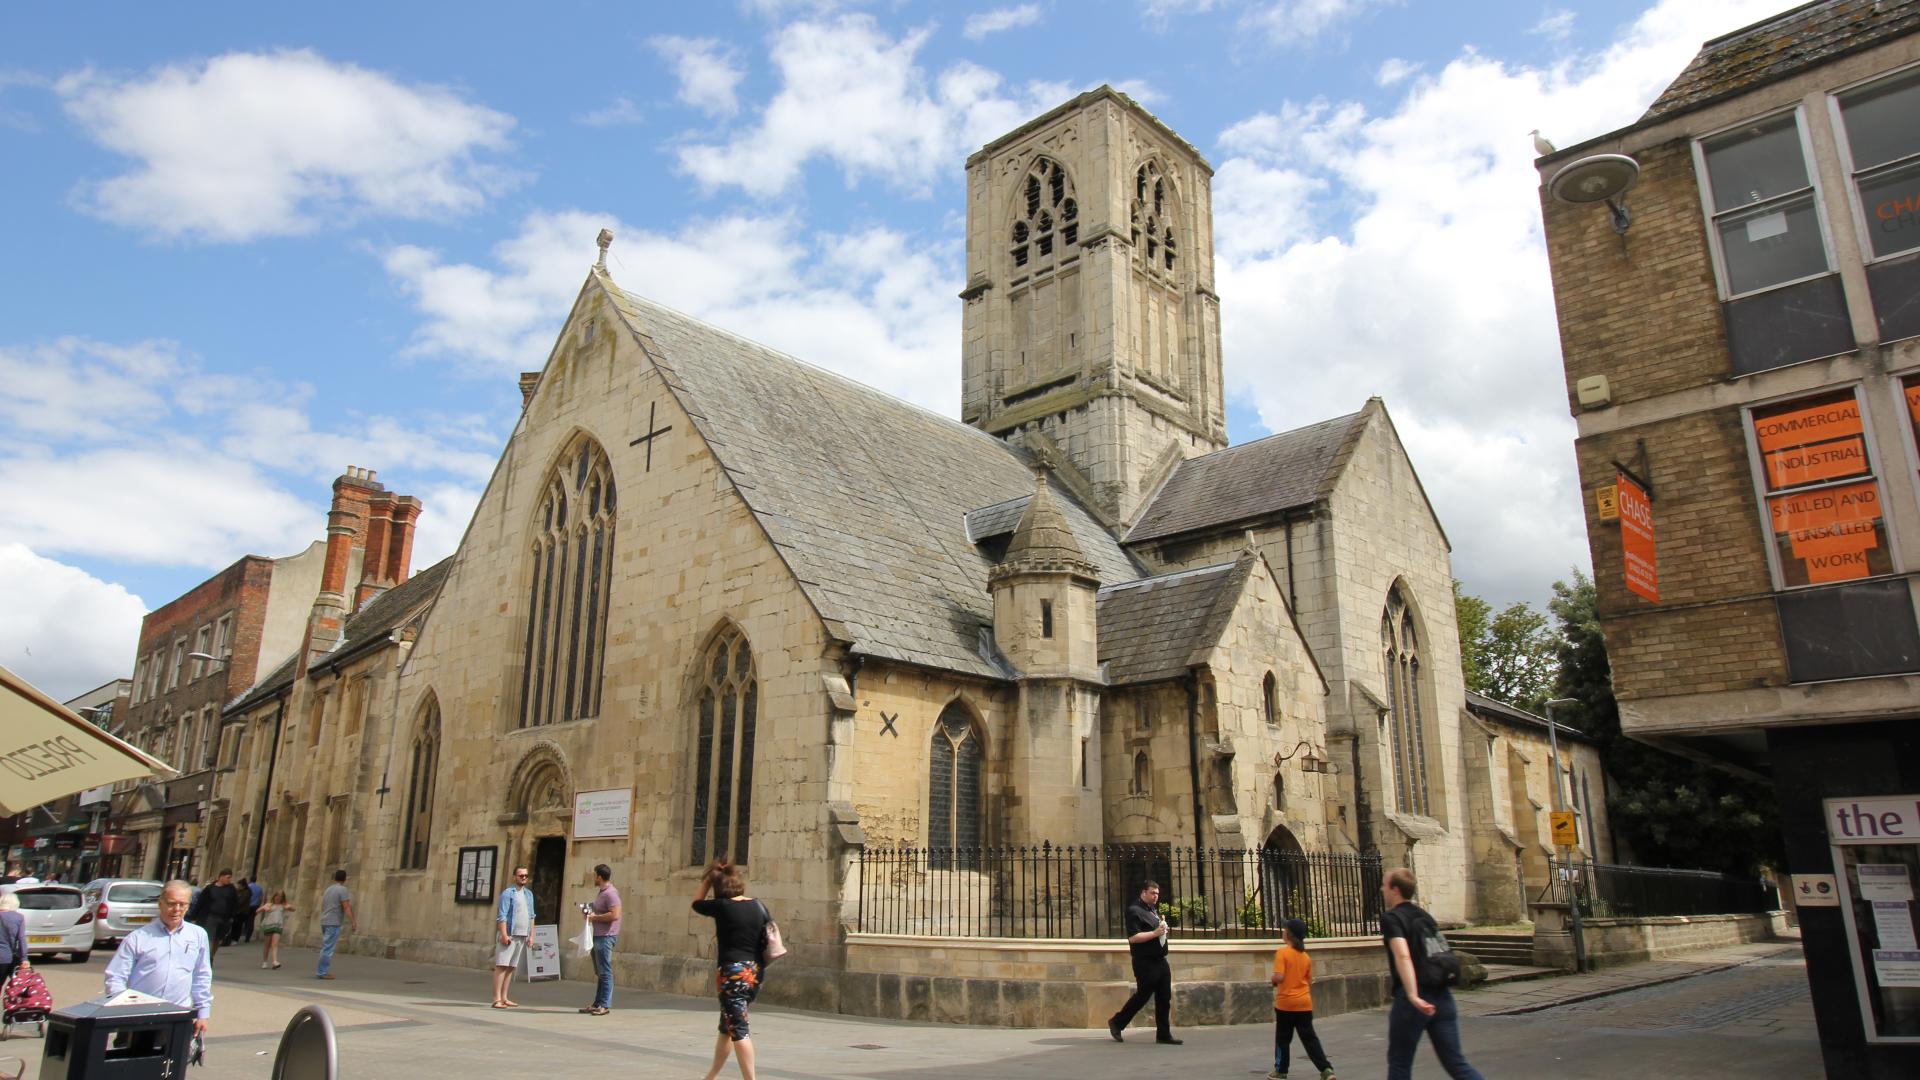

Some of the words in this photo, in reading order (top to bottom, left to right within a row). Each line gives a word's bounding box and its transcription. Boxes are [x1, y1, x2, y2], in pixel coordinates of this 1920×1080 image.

[1757, 407, 1860, 438] COMMERCIAL
[1774, 447, 1863, 471] INDUSTRIAL
[1620, 491, 1652, 530] CHASE
[1772, 497, 1834, 518] SKILLED
[1840, 490, 1876, 507] AND
[1795, 521, 1874, 543] UNSKILLED
[1811, 552, 1865, 569] WORK
[1836, 804, 1904, 836] the
